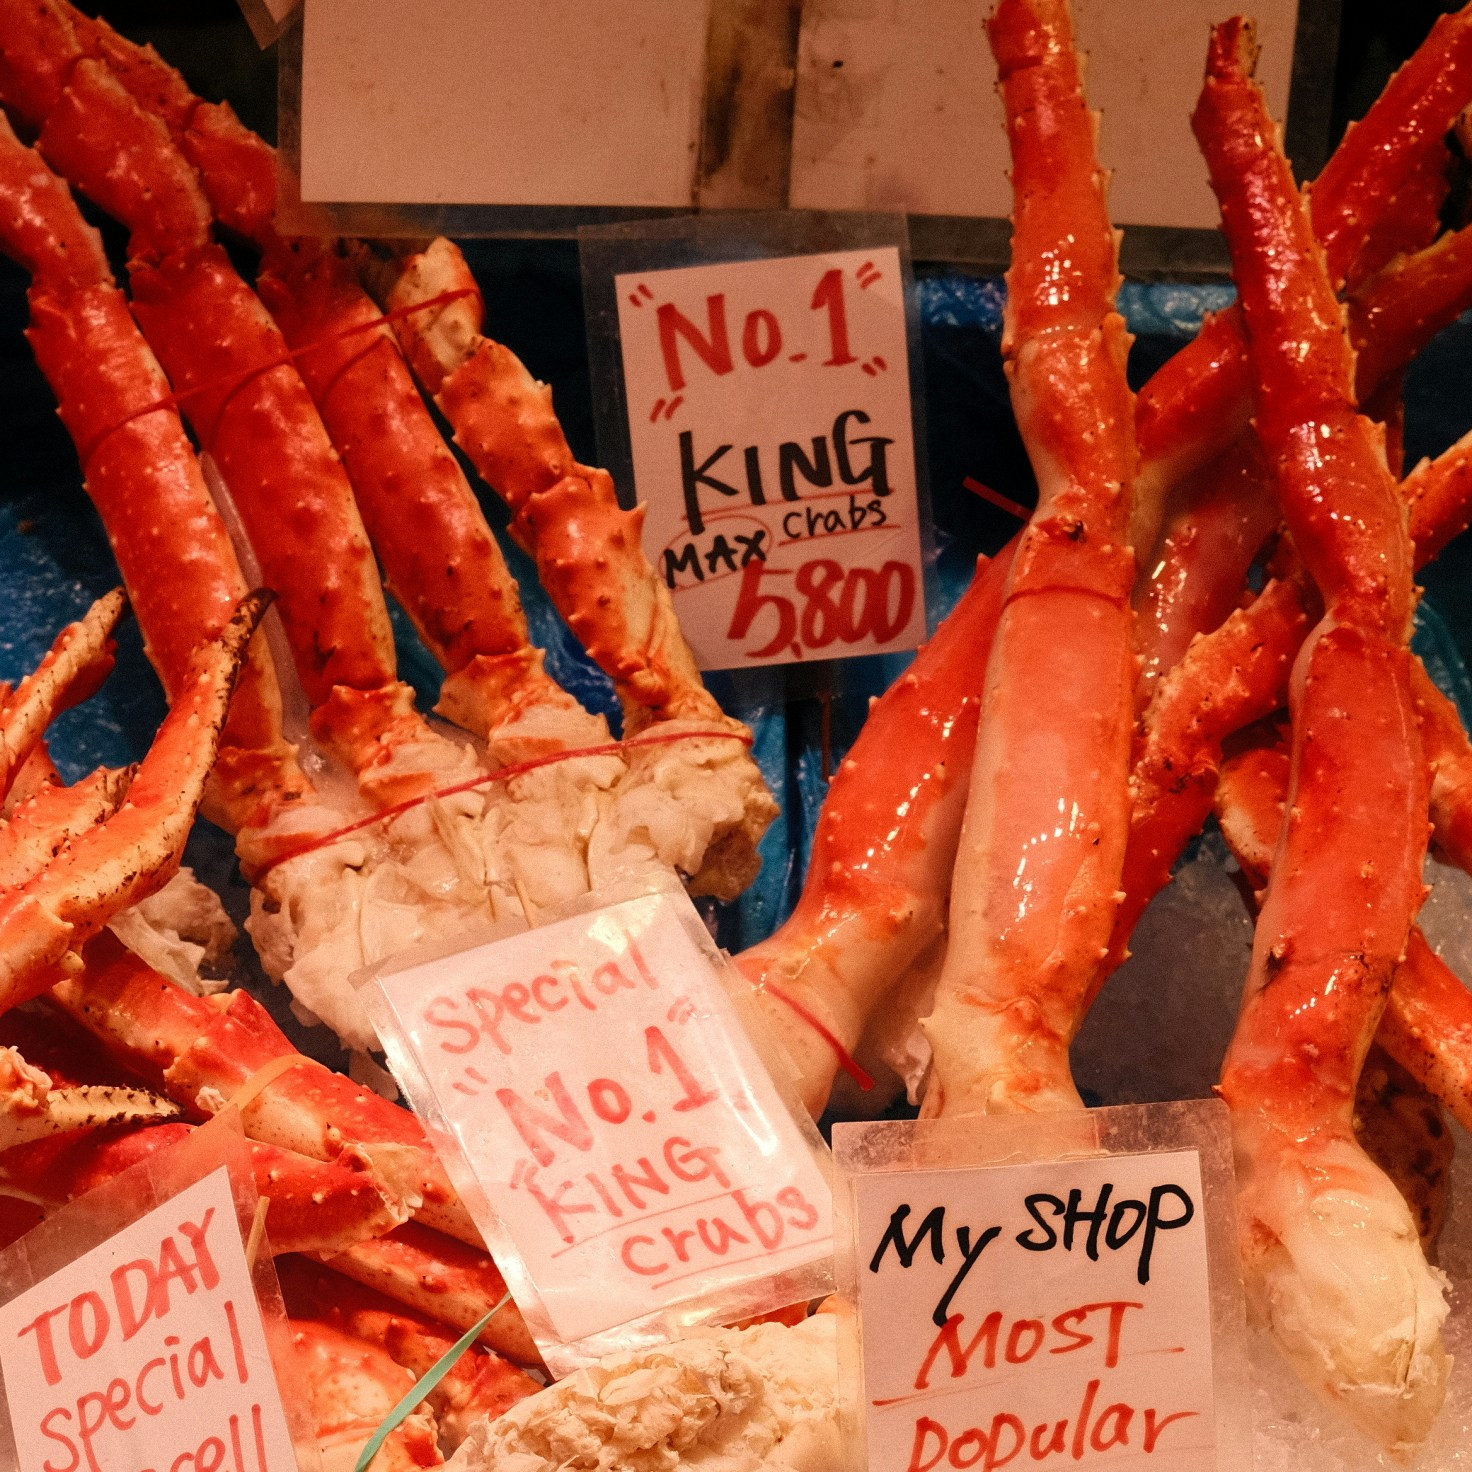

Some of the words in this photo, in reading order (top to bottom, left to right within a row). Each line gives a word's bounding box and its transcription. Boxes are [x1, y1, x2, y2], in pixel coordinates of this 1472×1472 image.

[662, 529, 767, 590] MAX
[17, 1206, 221, 1387] TODAY
[869, 1204, 1002, 1328] My
[914, 1300, 1144, 1390] MOST
